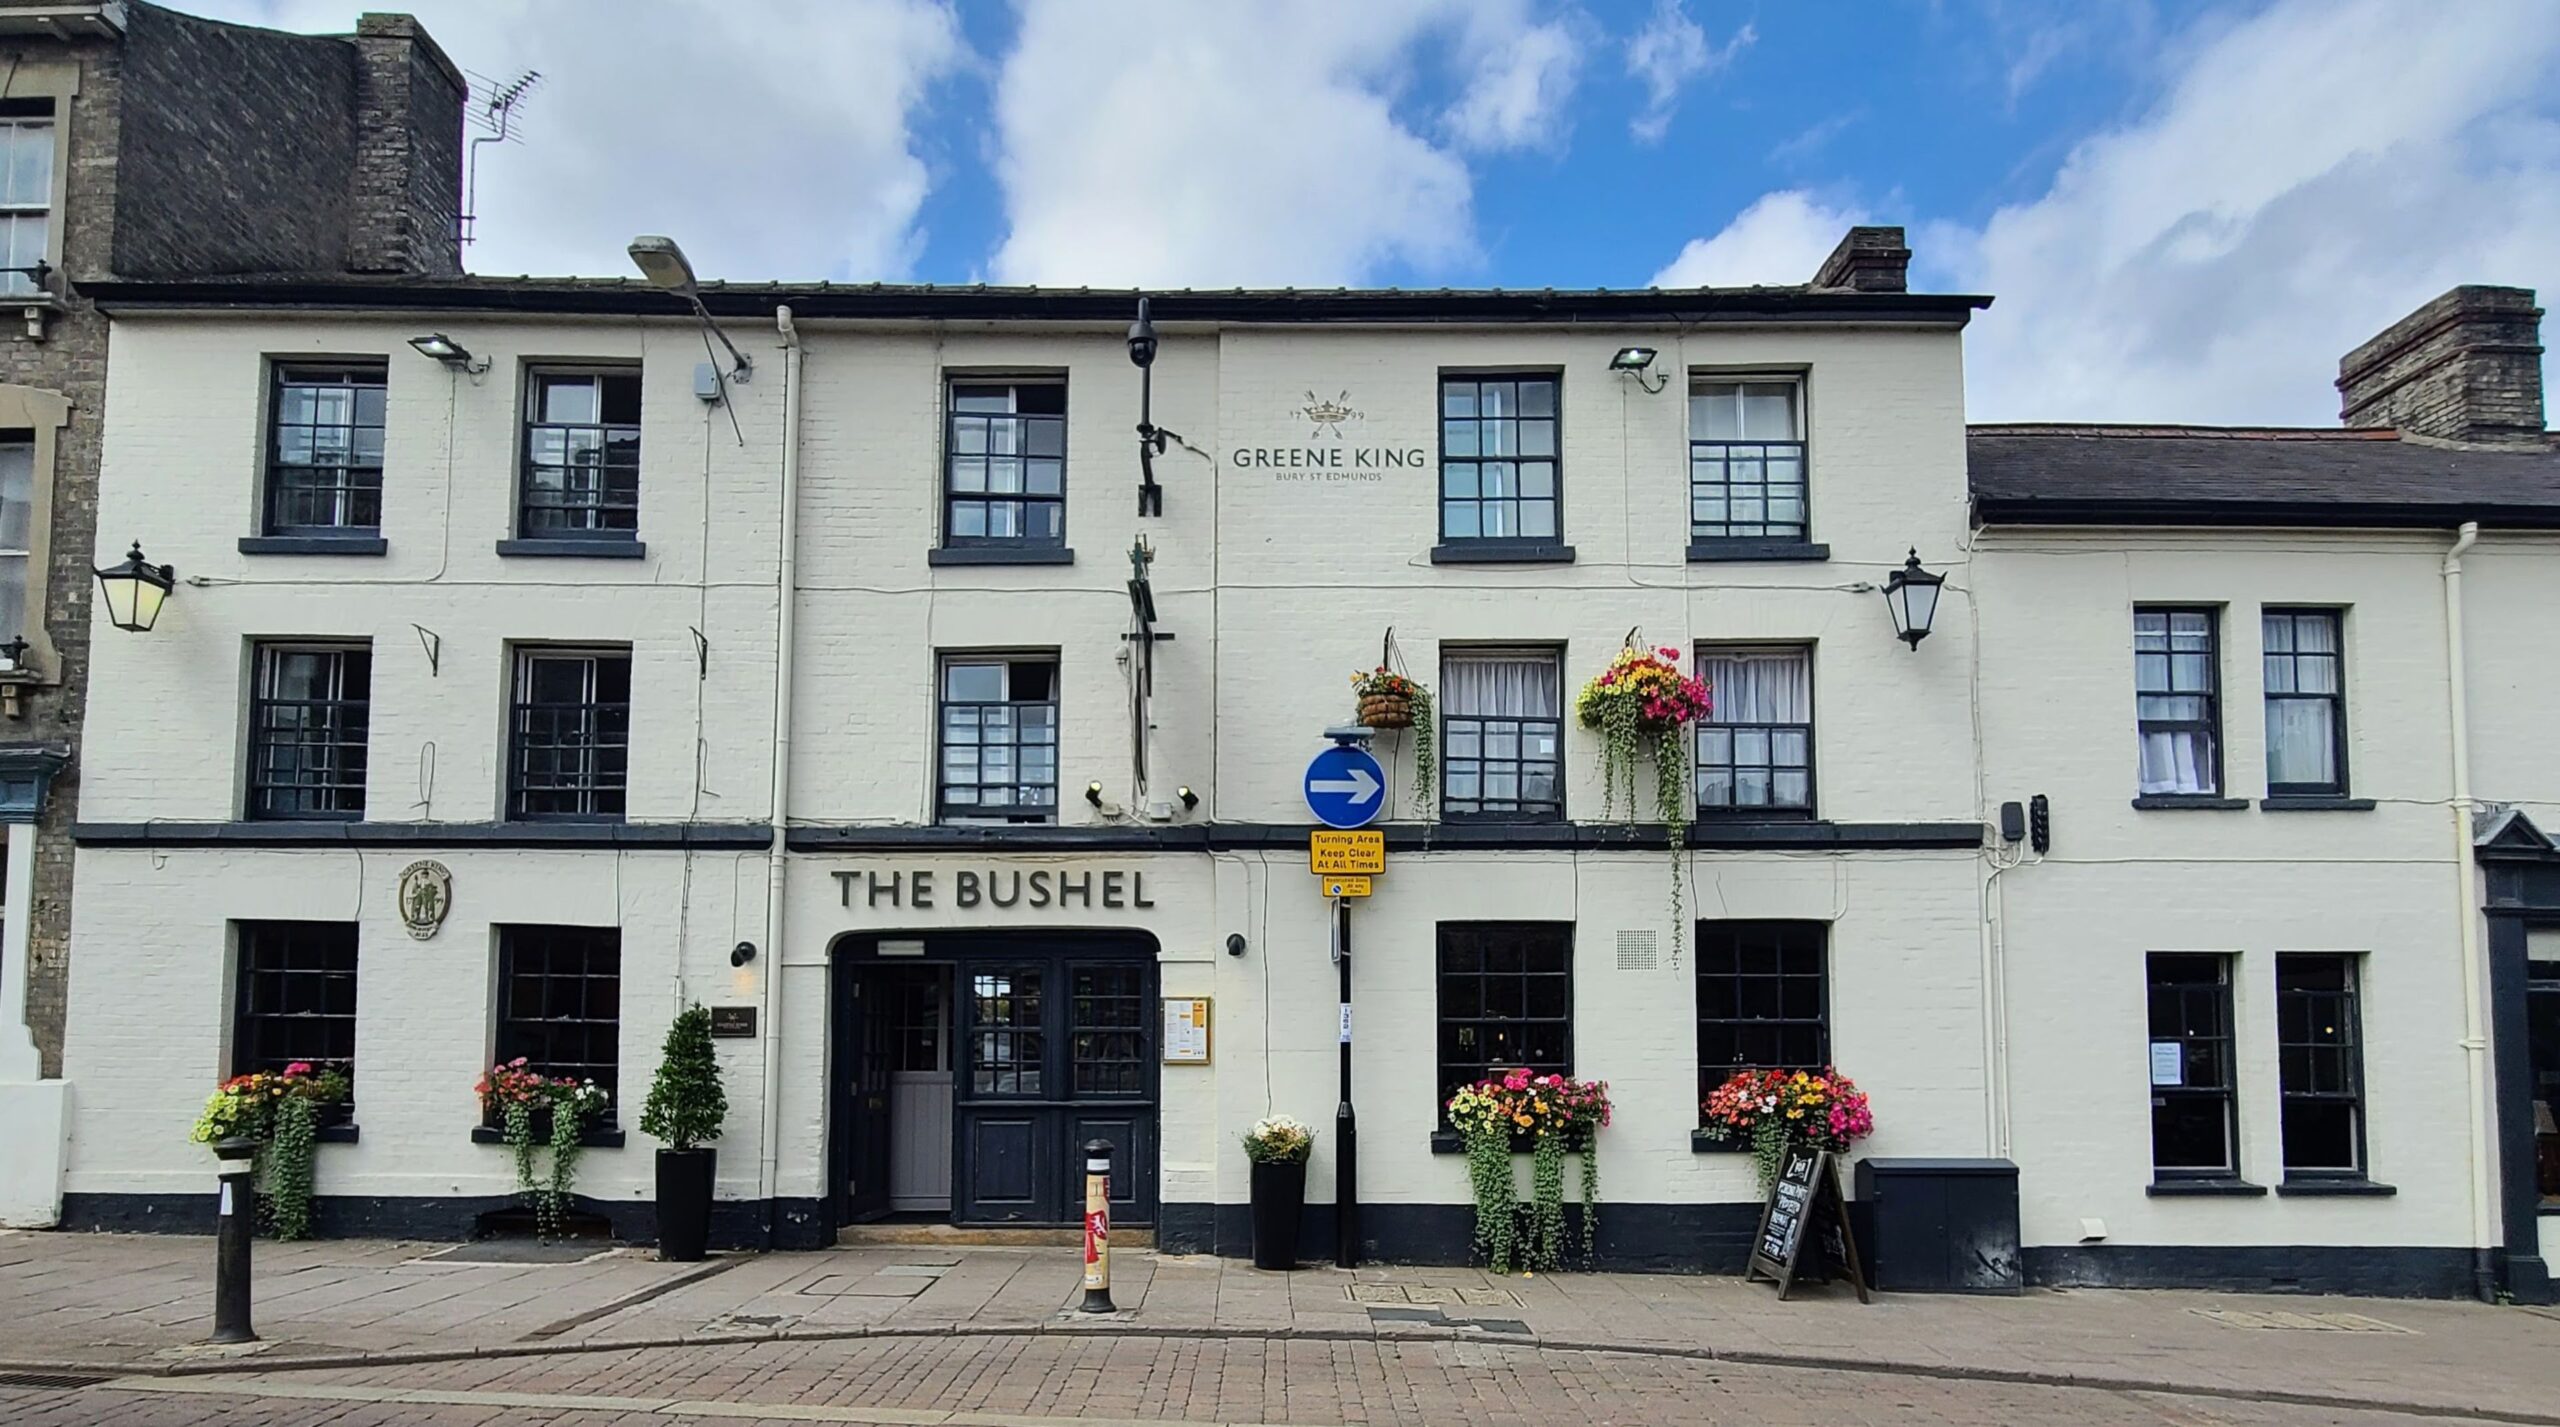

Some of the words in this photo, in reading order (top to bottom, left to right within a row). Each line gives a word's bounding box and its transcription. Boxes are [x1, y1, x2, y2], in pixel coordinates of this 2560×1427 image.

[1233, 448, 1343, 468] GREENE
[1355, 448, 1425, 468] KING
[1276, 472, 1305, 481] BURY
[1310, 472, 1322, 481] ST
[1326, 472, 1382, 481] EDMUNDS
[1315, 835, 1353, 845] Turning
[1356, 835, 1380, 844] Area
[1320, 848, 1345, 858] Keep
[1349, 848, 1376, 858] Clear
[1317, 860, 1329, 869] At
[1332, 860, 1347, 869] All
[1350, 860, 1379, 869] Times
[831, 871, 934, 908] THE
[956, 871, 1155, 908] BUSHEL
